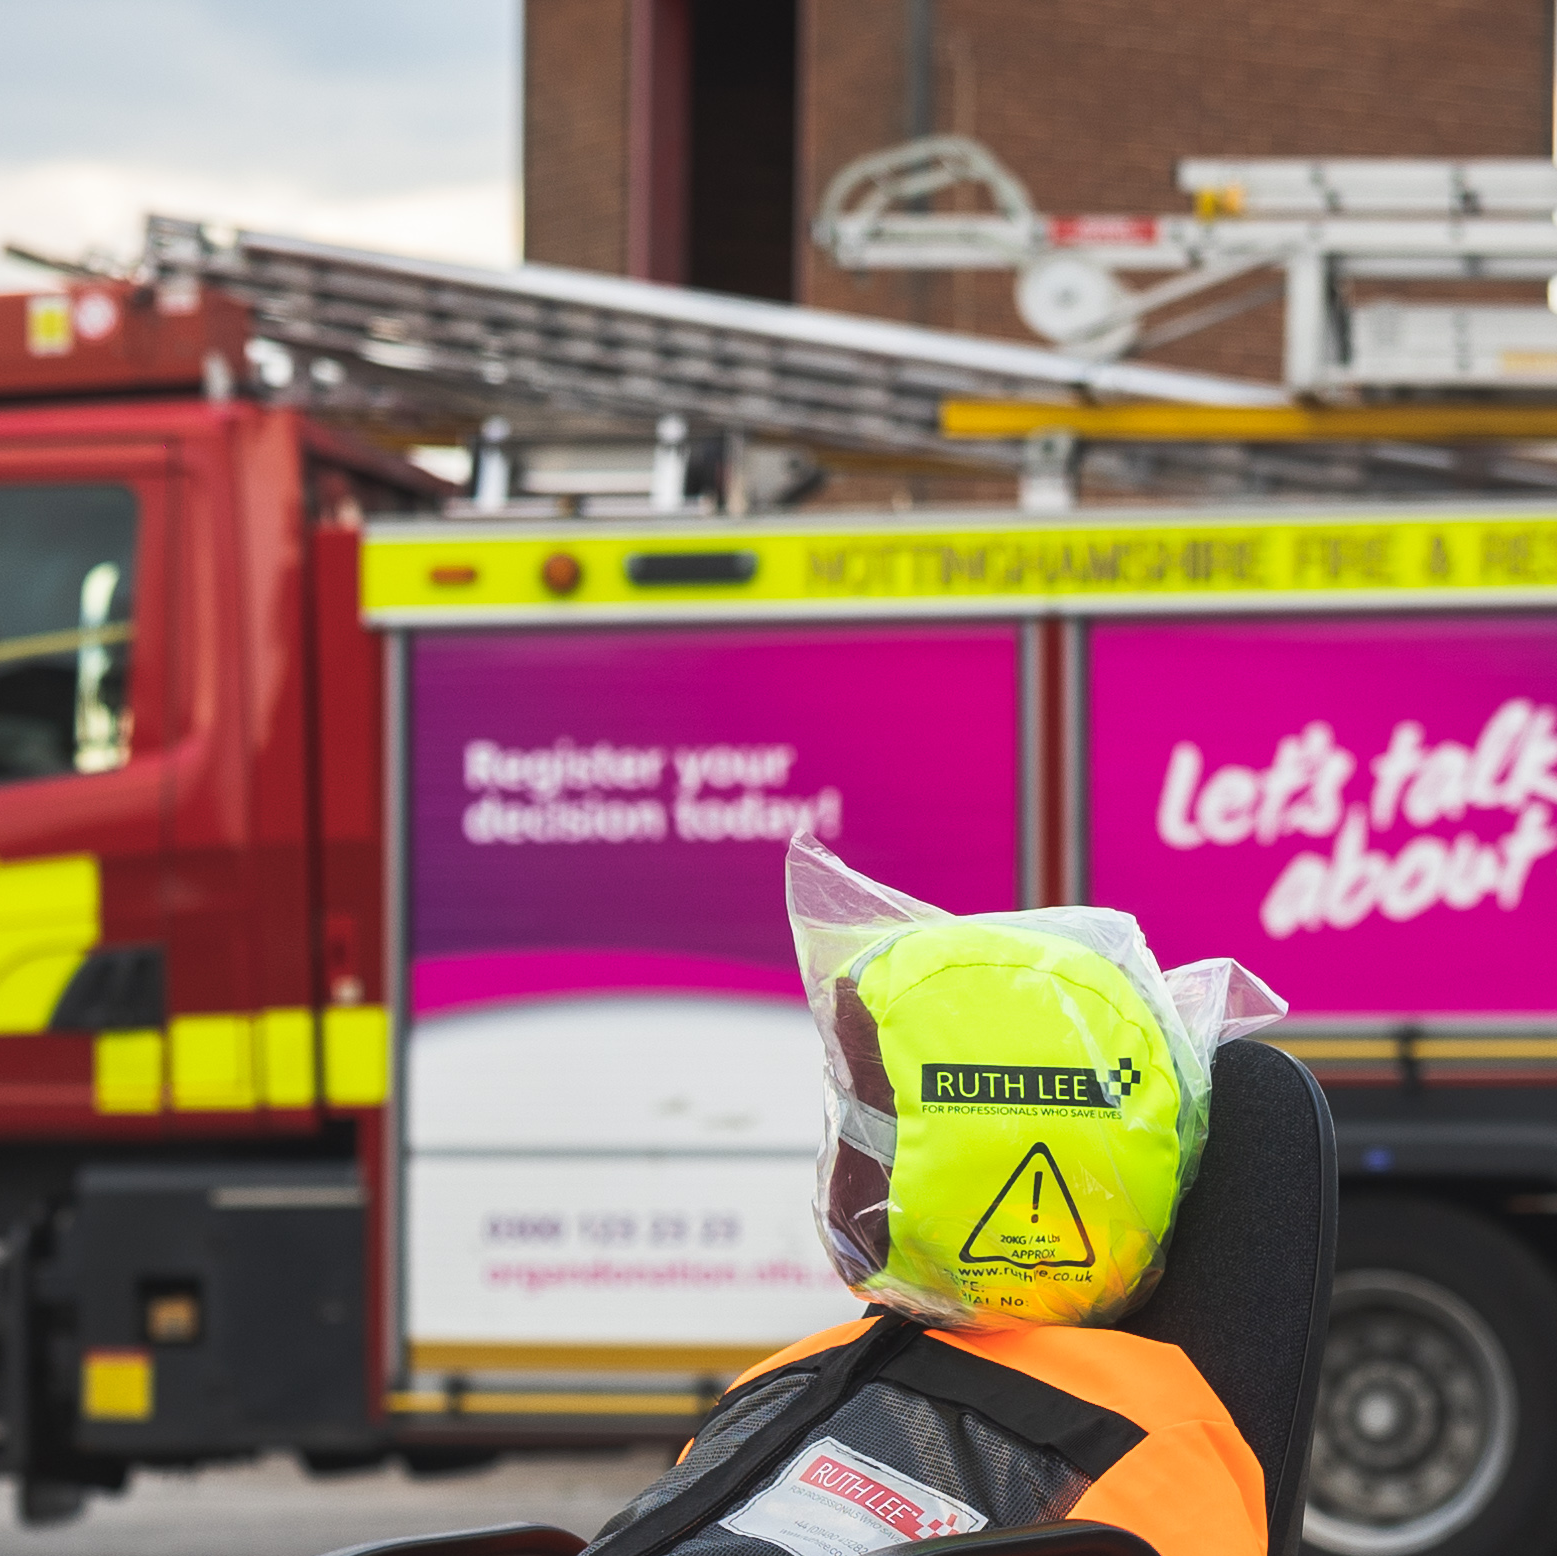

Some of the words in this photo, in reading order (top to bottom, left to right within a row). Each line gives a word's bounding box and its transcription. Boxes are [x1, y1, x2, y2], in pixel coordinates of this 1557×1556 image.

[1292, 527, 1405, 586] FIRE
[1423, 531, 1452, 581] &
[463, 737, 665, 801] Register
[673, 742, 797, 799] your
[1157, 720, 1357, 850] Let's
[462, 790, 668, 844] decision
[674, 785, 843, 846] today!
[936, 1071, 1024, 1099] RUTH
[1038, 1074, 1088, 1101] LEE
[922, 1105, 944, 1114] FOR
[947, 1106, 1038, 1116] PROFESSIONALS
[1041, 1108, 1068, 1117] WHO
[1071, 1109, 1096, 1118] SAVE
[1098, 1110, 1123, 1120] LIVES
[1000, 1234, 1027, 1245] 20KG
[1035, 1235, 1046, 1244] 44
[1048, 1234, 1060, 1244] Lbs
[1012, 1248, 1056, 1260] APPROX
[810, 1461, 875, 1501] RUTH
[789, 1485, 805, 1496] FOR
[804, 1490, 861, 1519] PROFESSIONALS
[860, 1514, 882, 1530] WHO
[879, 1527, 904, 1544] SAVE
